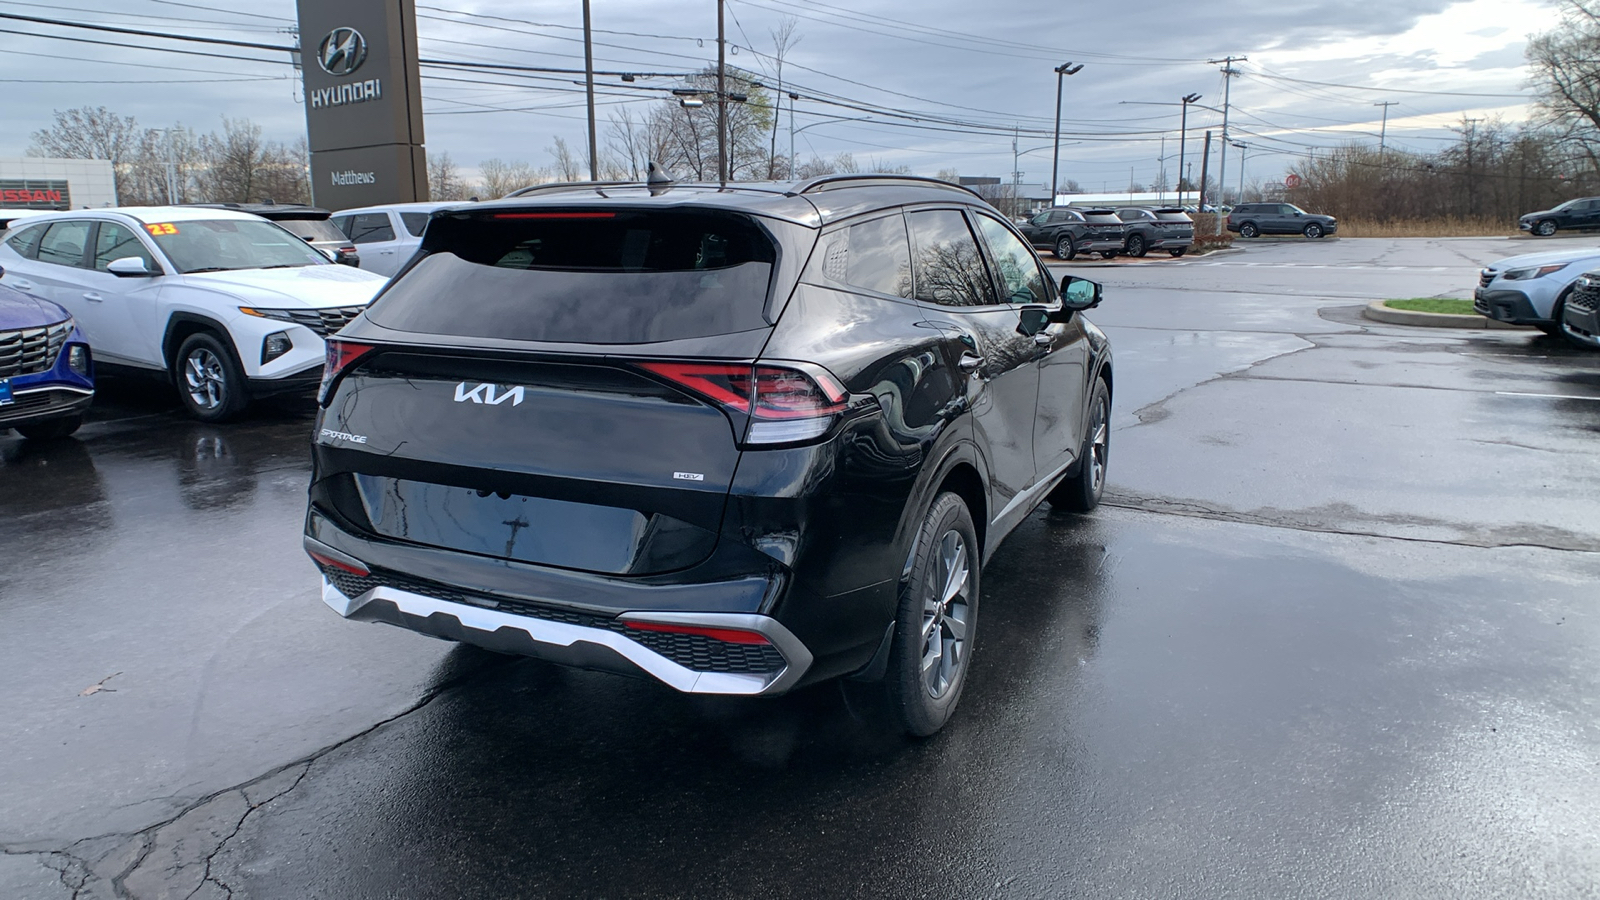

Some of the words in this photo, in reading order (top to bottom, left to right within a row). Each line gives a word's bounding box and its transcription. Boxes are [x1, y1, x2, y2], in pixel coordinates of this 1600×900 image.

[311, 79, 382, 108] HYUNDAI
[331, 170, 375, 186] Matthews
[0, 189, 61, 202] ISSAN
[147, 222, 177, 236] 23
[454, 381, 524, 407] KIA
[320, 428, 368, 444] SPORTAGE
